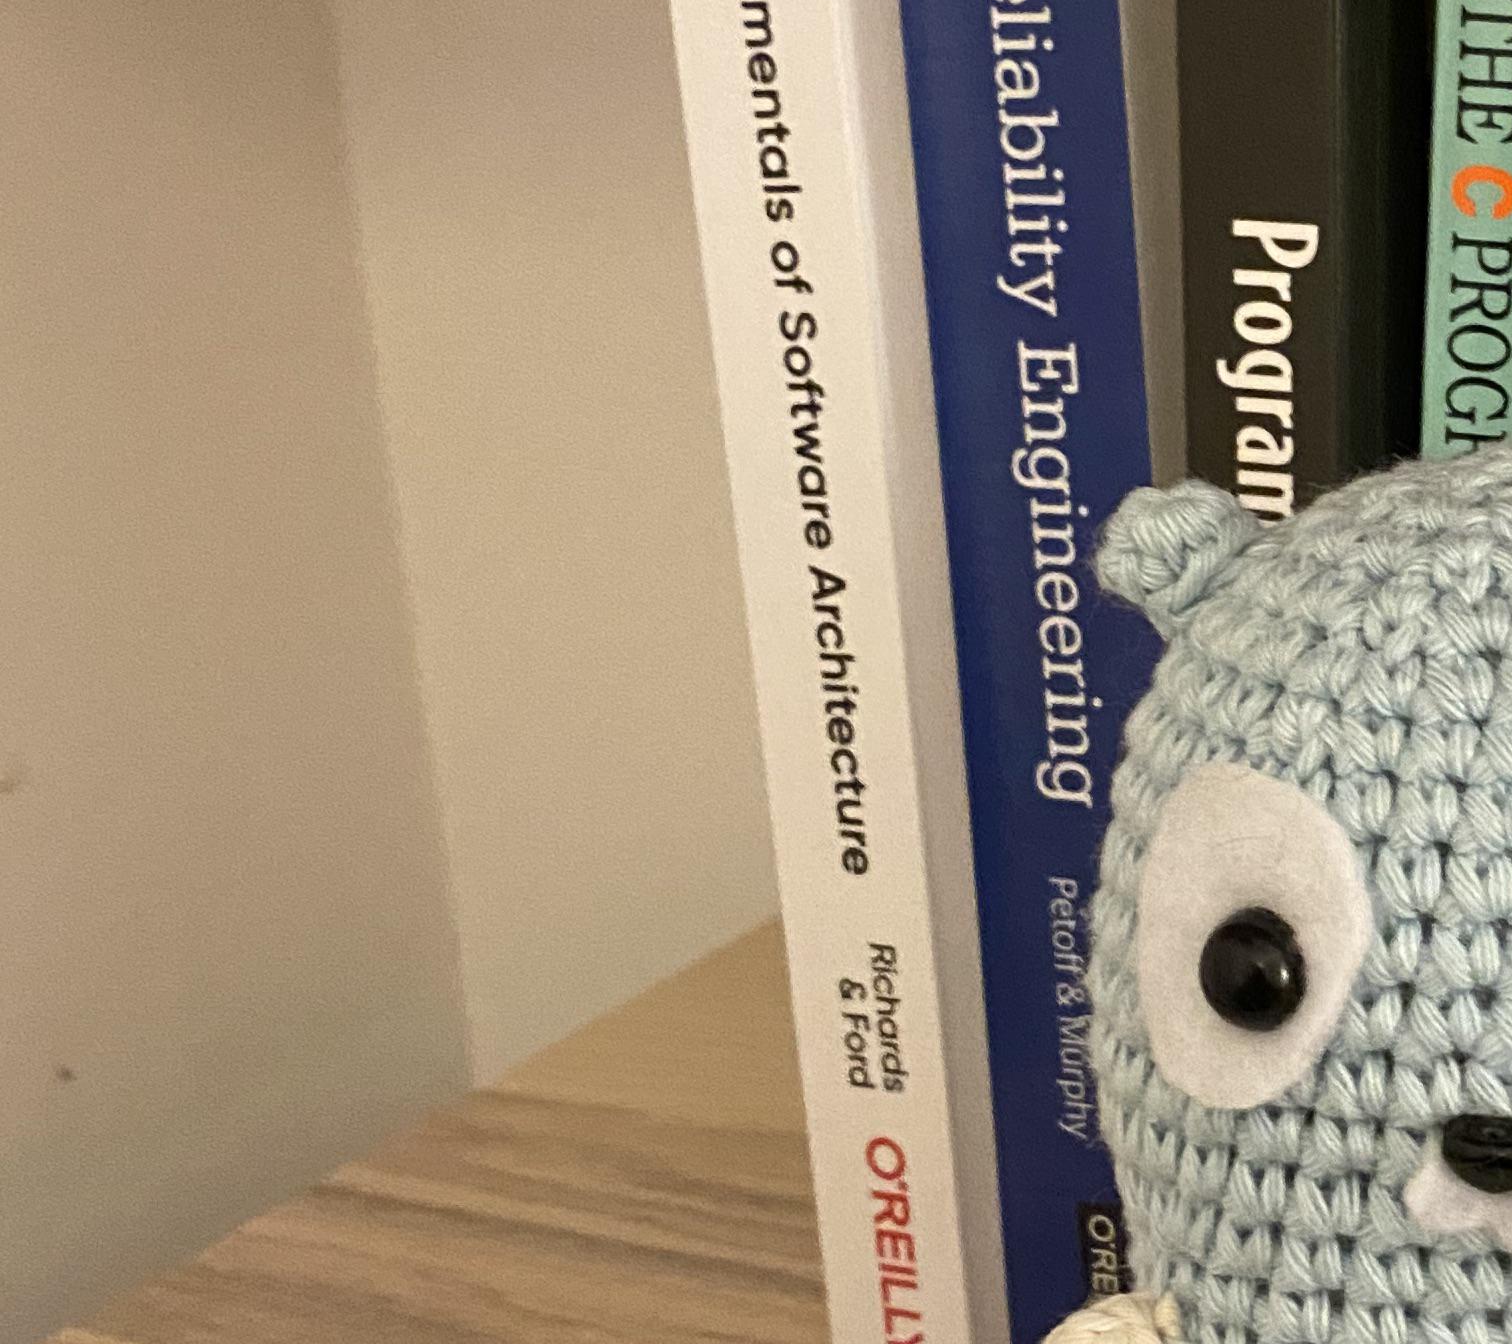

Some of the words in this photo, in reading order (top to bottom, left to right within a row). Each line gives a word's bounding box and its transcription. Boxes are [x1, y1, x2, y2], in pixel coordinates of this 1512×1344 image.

[771, 239, 813, 295] of
[780, 312, 833, 551] Software
[1010, 342, 1101, 807] Engineering
[809, 565, 870, 876] Architecture
[1048, 876, 1086, 973] Petoff
[839, 978, 866, 1001] &
[869, 941, 907, 1093] Richards
[1056, 982, 1085, 1007] &
[843, 1016, 873, 1089] Ford
[1056, 1014, 1097, 1141] Murphy
